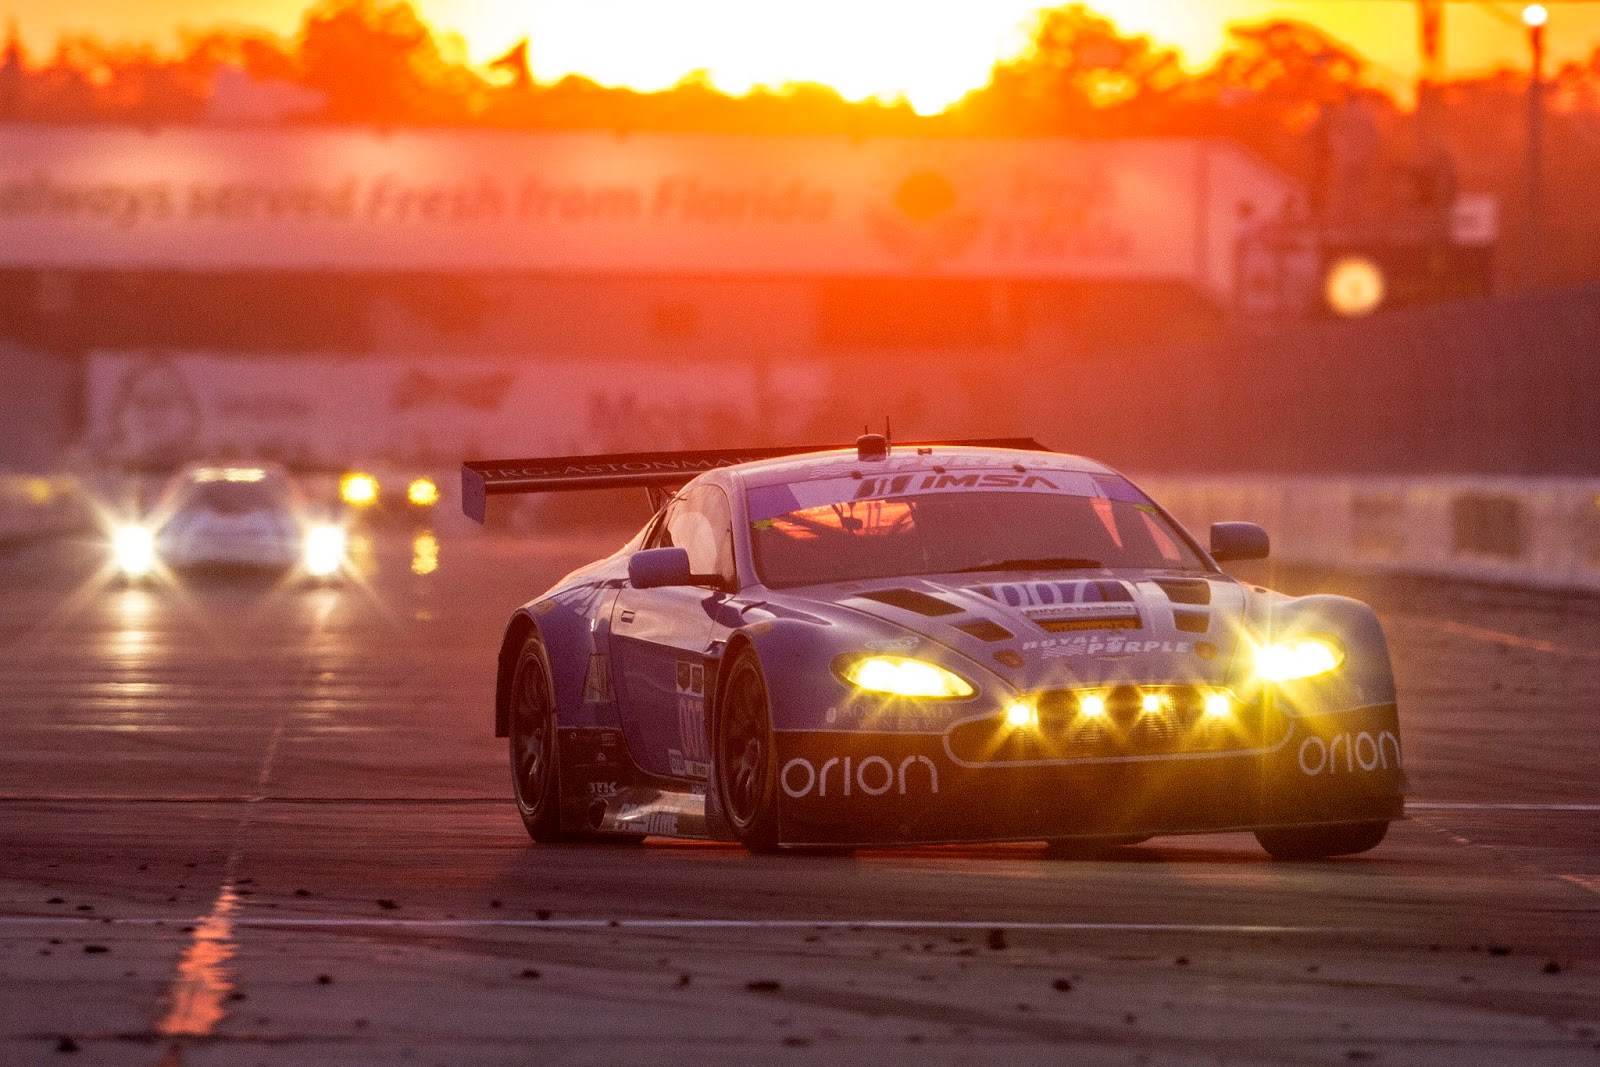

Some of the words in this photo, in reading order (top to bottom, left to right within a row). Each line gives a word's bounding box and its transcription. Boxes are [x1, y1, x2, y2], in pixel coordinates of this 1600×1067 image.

[651, 172, 837, 222] Florida
[919, 474, 1059, 490] IMSA
[1022, 636, 1099, 650] ROYAL
[1086, 641, 1190, 654] PURPLE
[1298, 730, 1402, 776] orion
[780, 755, 939, 798] orion
